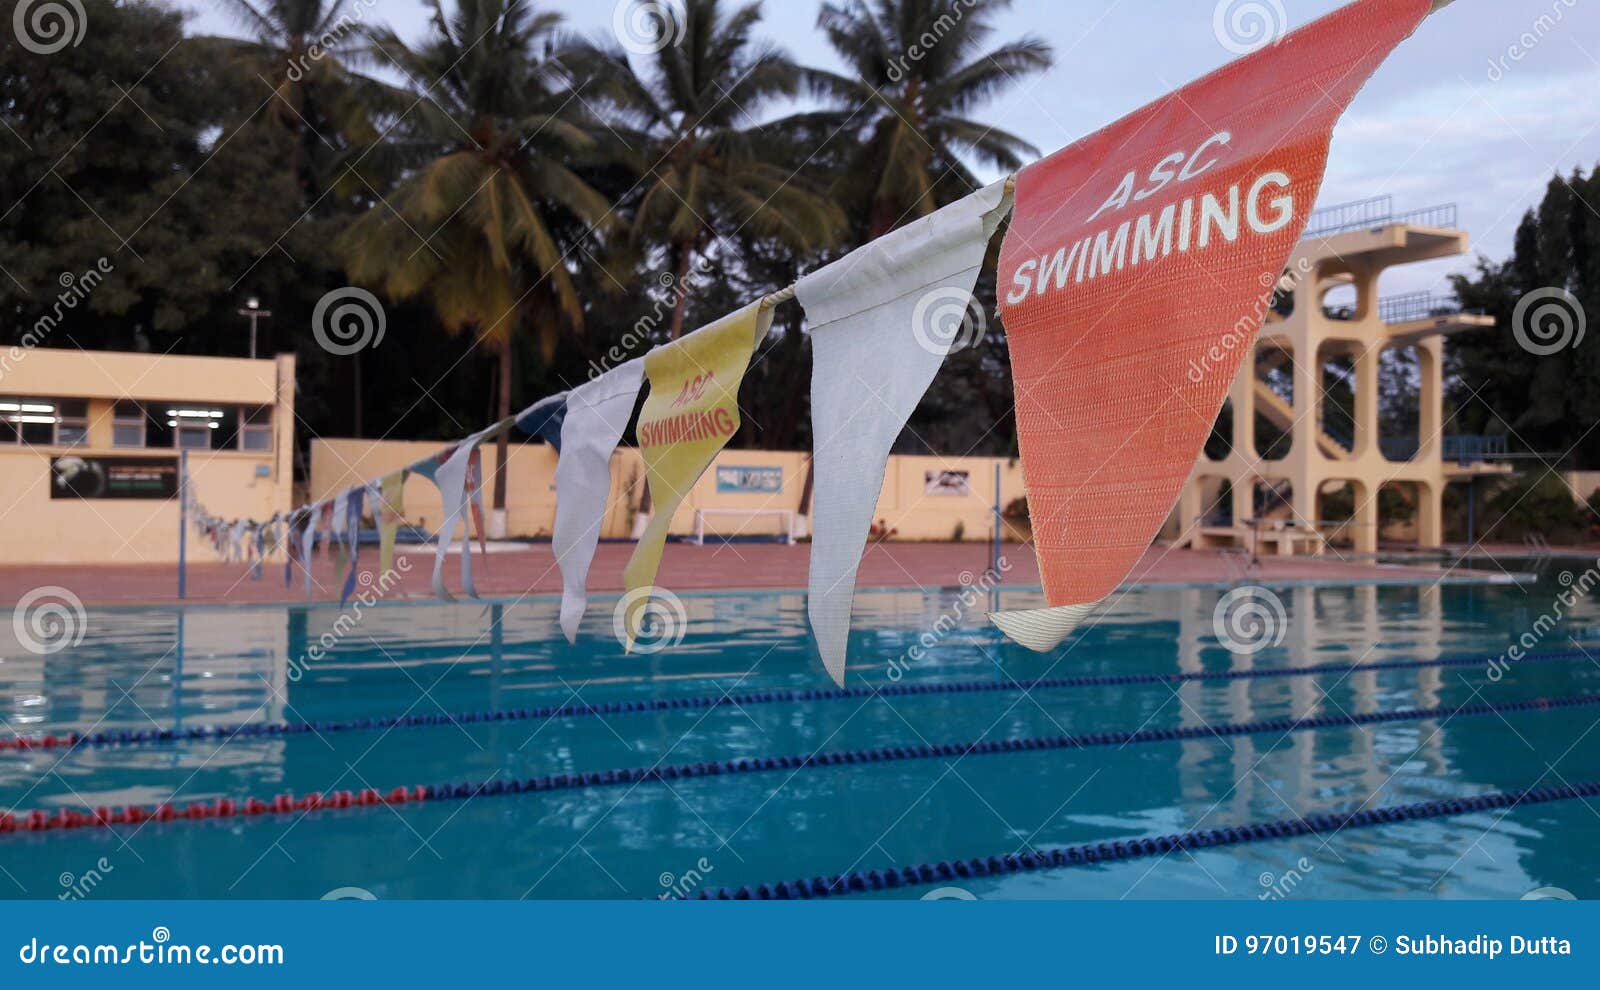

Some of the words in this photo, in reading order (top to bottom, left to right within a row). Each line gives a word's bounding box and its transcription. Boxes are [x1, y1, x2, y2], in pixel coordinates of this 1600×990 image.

[1084, 132, 1231, 223] ASC
[1007, 171, 1293, 304] SWIMMING
[641, 407, 735, 449] SWIMMING
